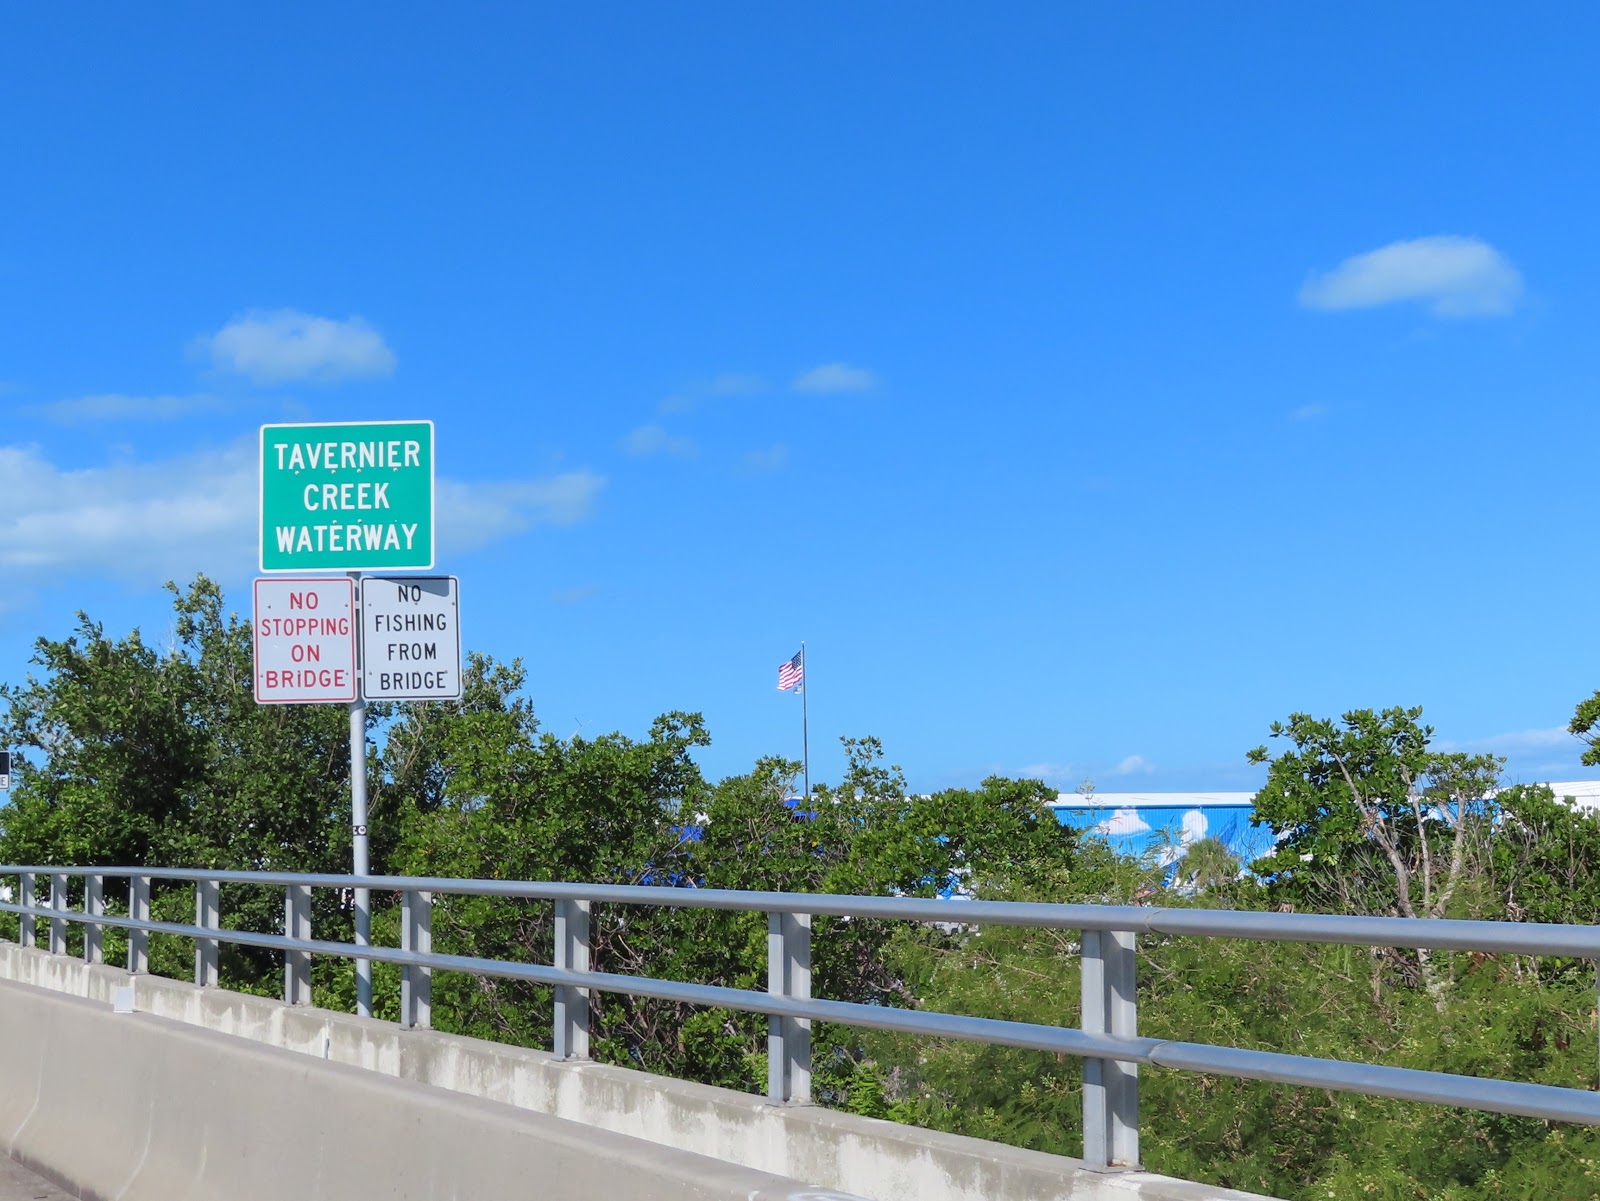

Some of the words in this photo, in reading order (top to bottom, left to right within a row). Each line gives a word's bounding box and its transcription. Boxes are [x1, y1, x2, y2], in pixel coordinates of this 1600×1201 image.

[274, 440, 421, 470] TAVERNIER
[303, 482, 390, 511] CREEK
[275, 523, 418, 553] WATERWAY
[289, 592, 319, 610] NO
[397, 585, 422, 603] NO
[261, 618, 349, 637] STOPPING
[375, 613, 447, 632] FISHING
[291, 645, 320, 662] ON
[387, 642, 437, 661] FROM
[265, 669, 346, 688] BRIDGE
[380, 671, 446, 691] BRIDGE
